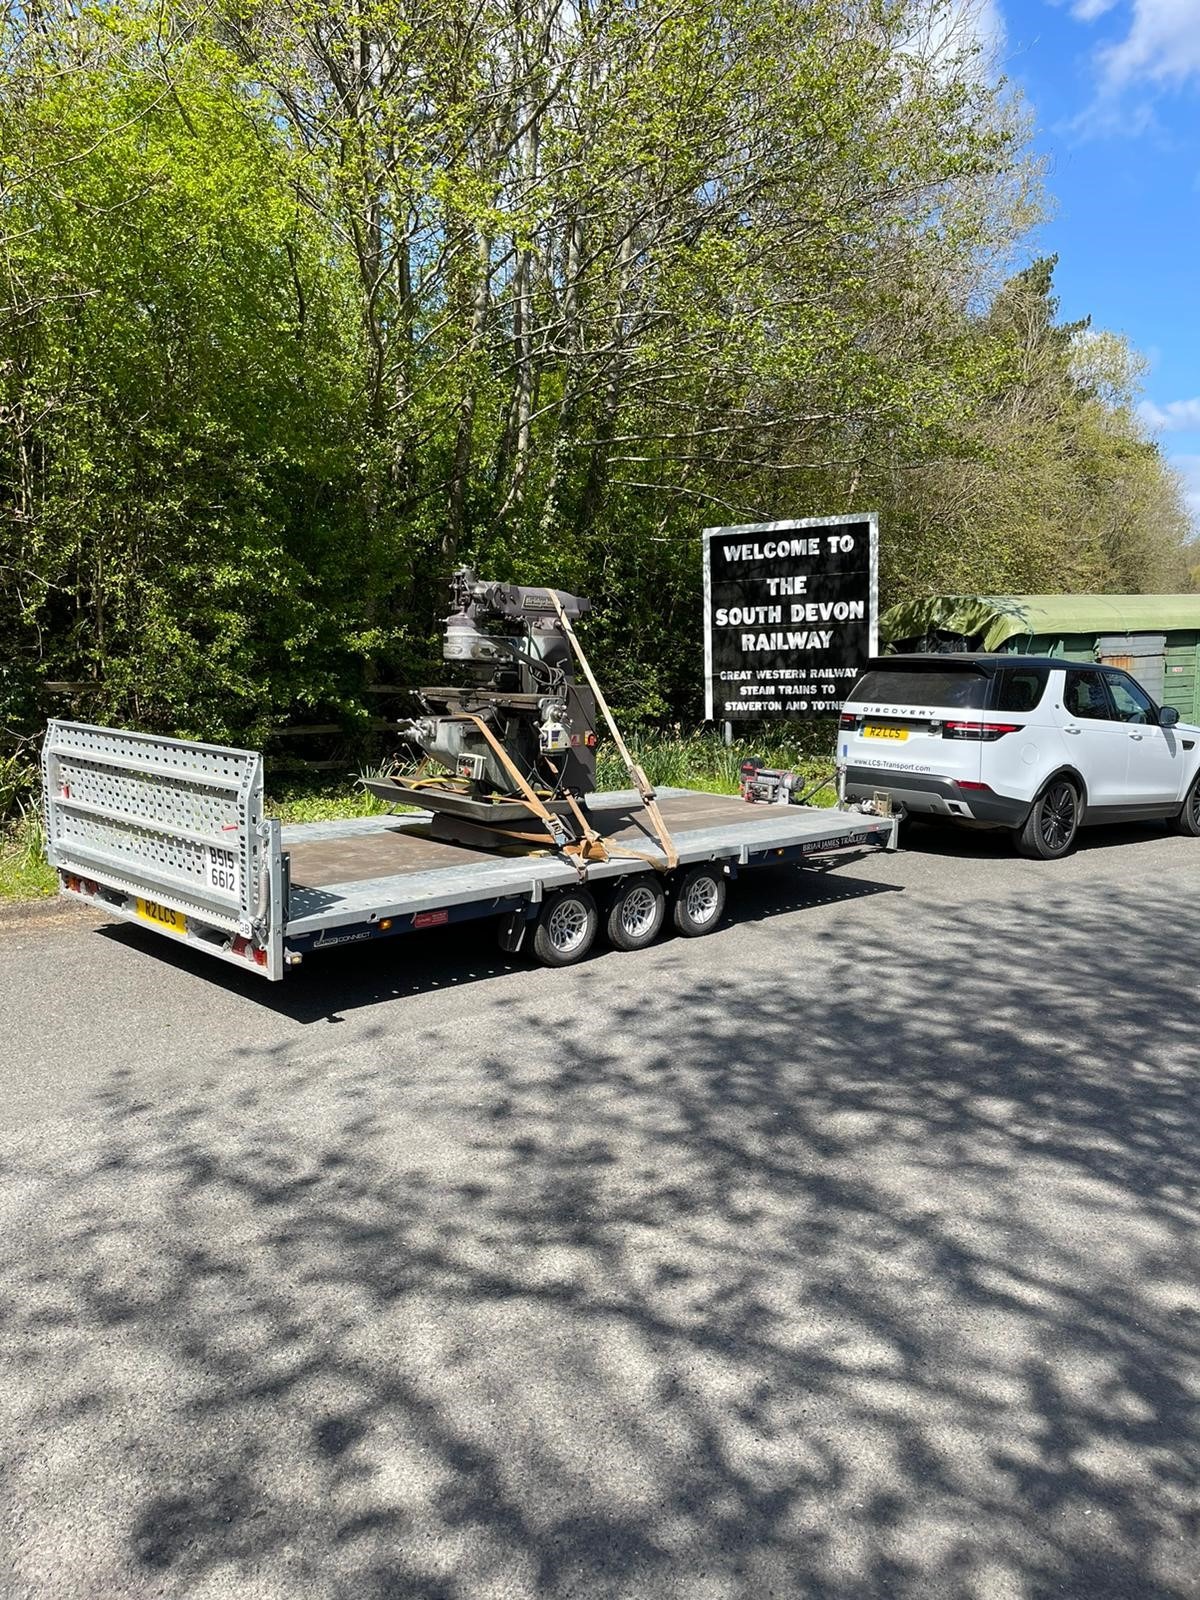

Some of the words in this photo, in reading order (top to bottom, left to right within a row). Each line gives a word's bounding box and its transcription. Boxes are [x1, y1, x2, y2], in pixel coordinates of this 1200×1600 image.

[723, 537, 820, 562] WELCOME
[827, 534, 855, 554] TO
[766, 575, 807, 596] THE
[715, 605, 782, 626] SOUTH
[790, 600, 865, 623] DEVON
[741, 630, 834, 652] RAILWAY
[719, 670, 752, 681] GREAT
[756, 669, 806, 680] WESTERN
[809, 667, 859, 679] RAILWAY
[739, 685, 775, 696] STEAM
[778, 684, 817, 695] TRAINS
[821, 684, 836, 694] TO
[724, 700, 782, 711] STAVERTON
[785, 700, 807, 711] AND
[811, 700, 845, 711] TOTNE
[863, 706, 936, 716] DISCOVERY
[869, 726, 883, 738] R2
[883, 727, 902, 739] LCS
[854, 759, 931, 773] www.LCS-Transport.com
[802, 841, 821, 852] BRIAN
[820, 838, 840, 850] JAMES
[211, 867, 236, 892] 6612
[338, 931, 371, 943] CONNECT
